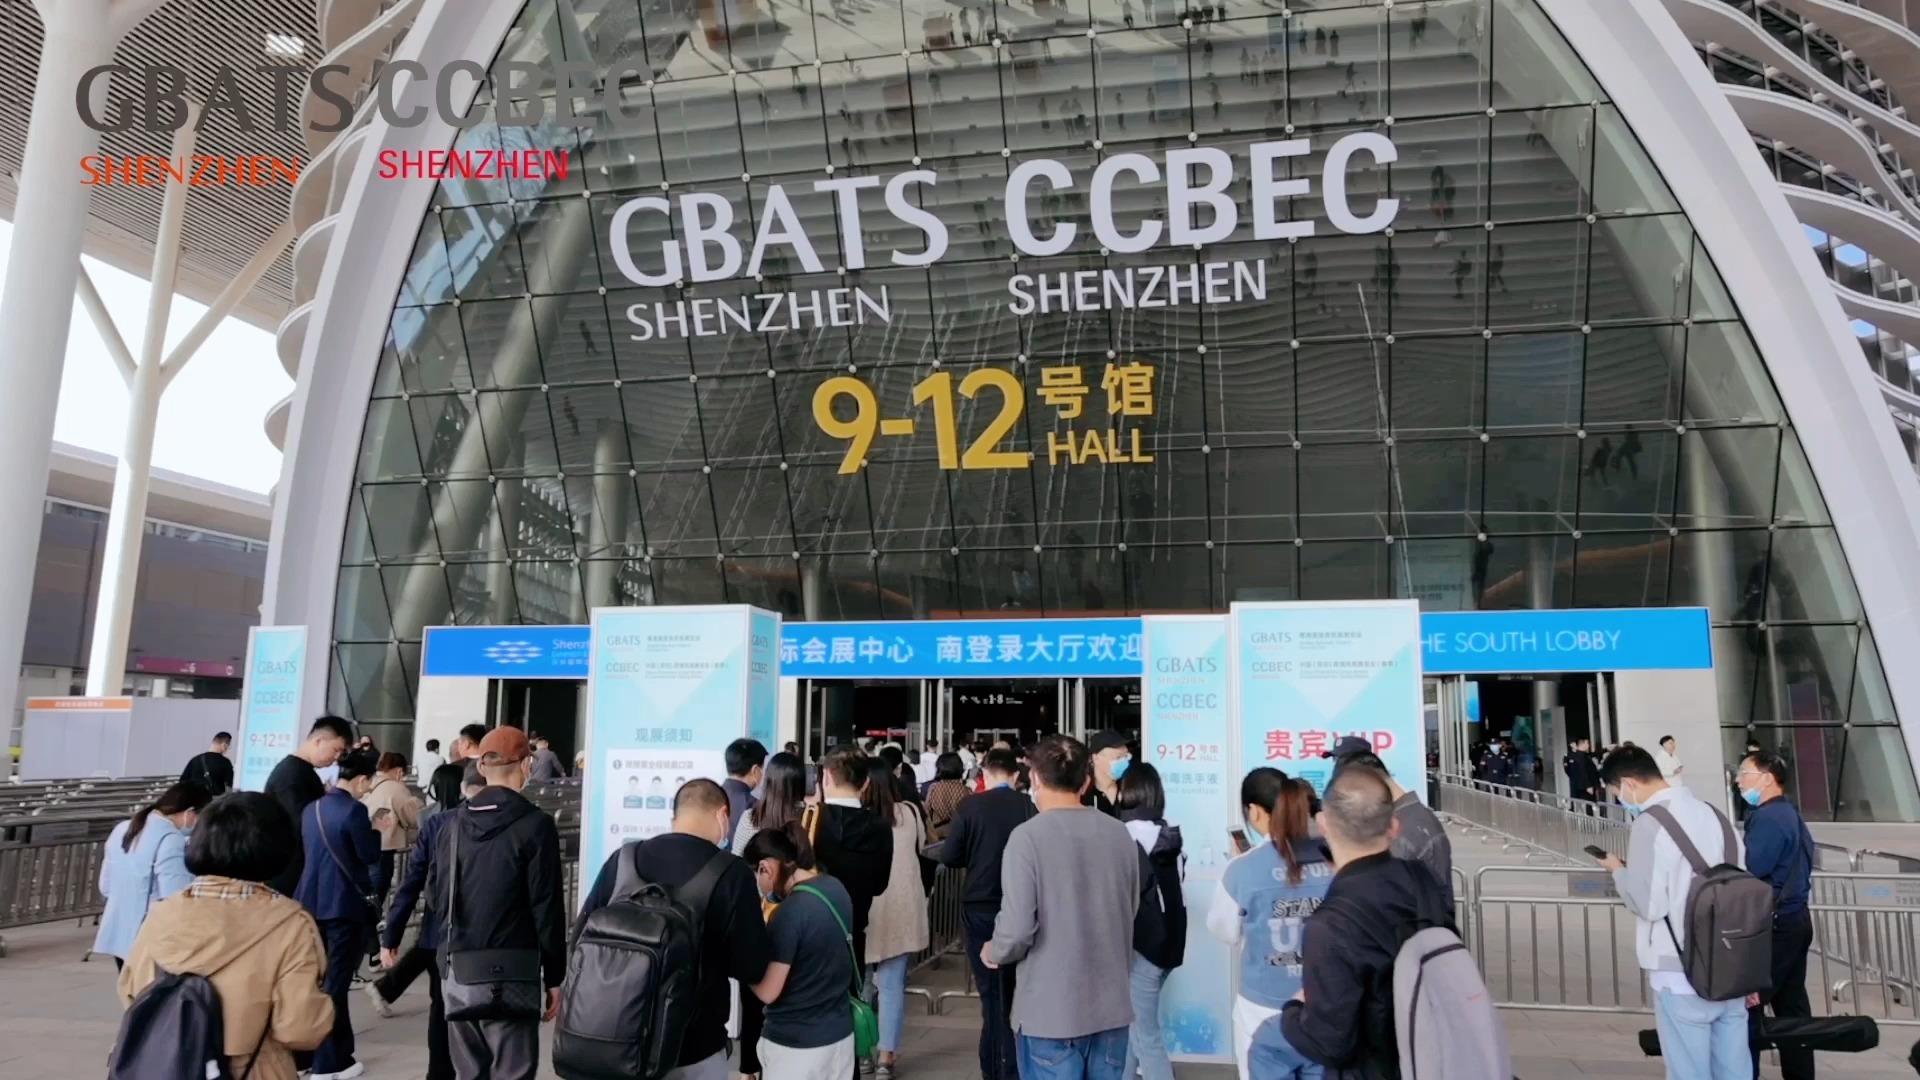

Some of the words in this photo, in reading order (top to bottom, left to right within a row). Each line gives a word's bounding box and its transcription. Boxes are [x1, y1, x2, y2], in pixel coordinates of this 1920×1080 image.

[1005, 130, 1400, 257] CCBEC
[608, 168, 951, 288] GBATS
[1007, 258, 1268, 315] SHENZHEN
[625, 283, 892, 342] SHENZHEN
[1036, 361, 1155, 421] 号馆
[811, 365, 1033, 475] 9-12
[1046, 428, 1154, 467] HALL
[606, 634, 641, 646] GBATS
[1251, 631, 1292, 643] GBATS
[1455, 631, 1537, 653] SOUTH
[1545, 629, 1622, 651] LOBBY
[257, 660, 297, 674] GBATS
[605, 661, 640, 673] CCBEC
[1156, 657, 1217, 673] GBATS
[1251, 660, 1293, 672] CCBEC
[1156, 692, 1217, 709] CCBEC
[635, 727, 693, 743] 观展须知
[1156, 743, 1196, 761] 9-12
